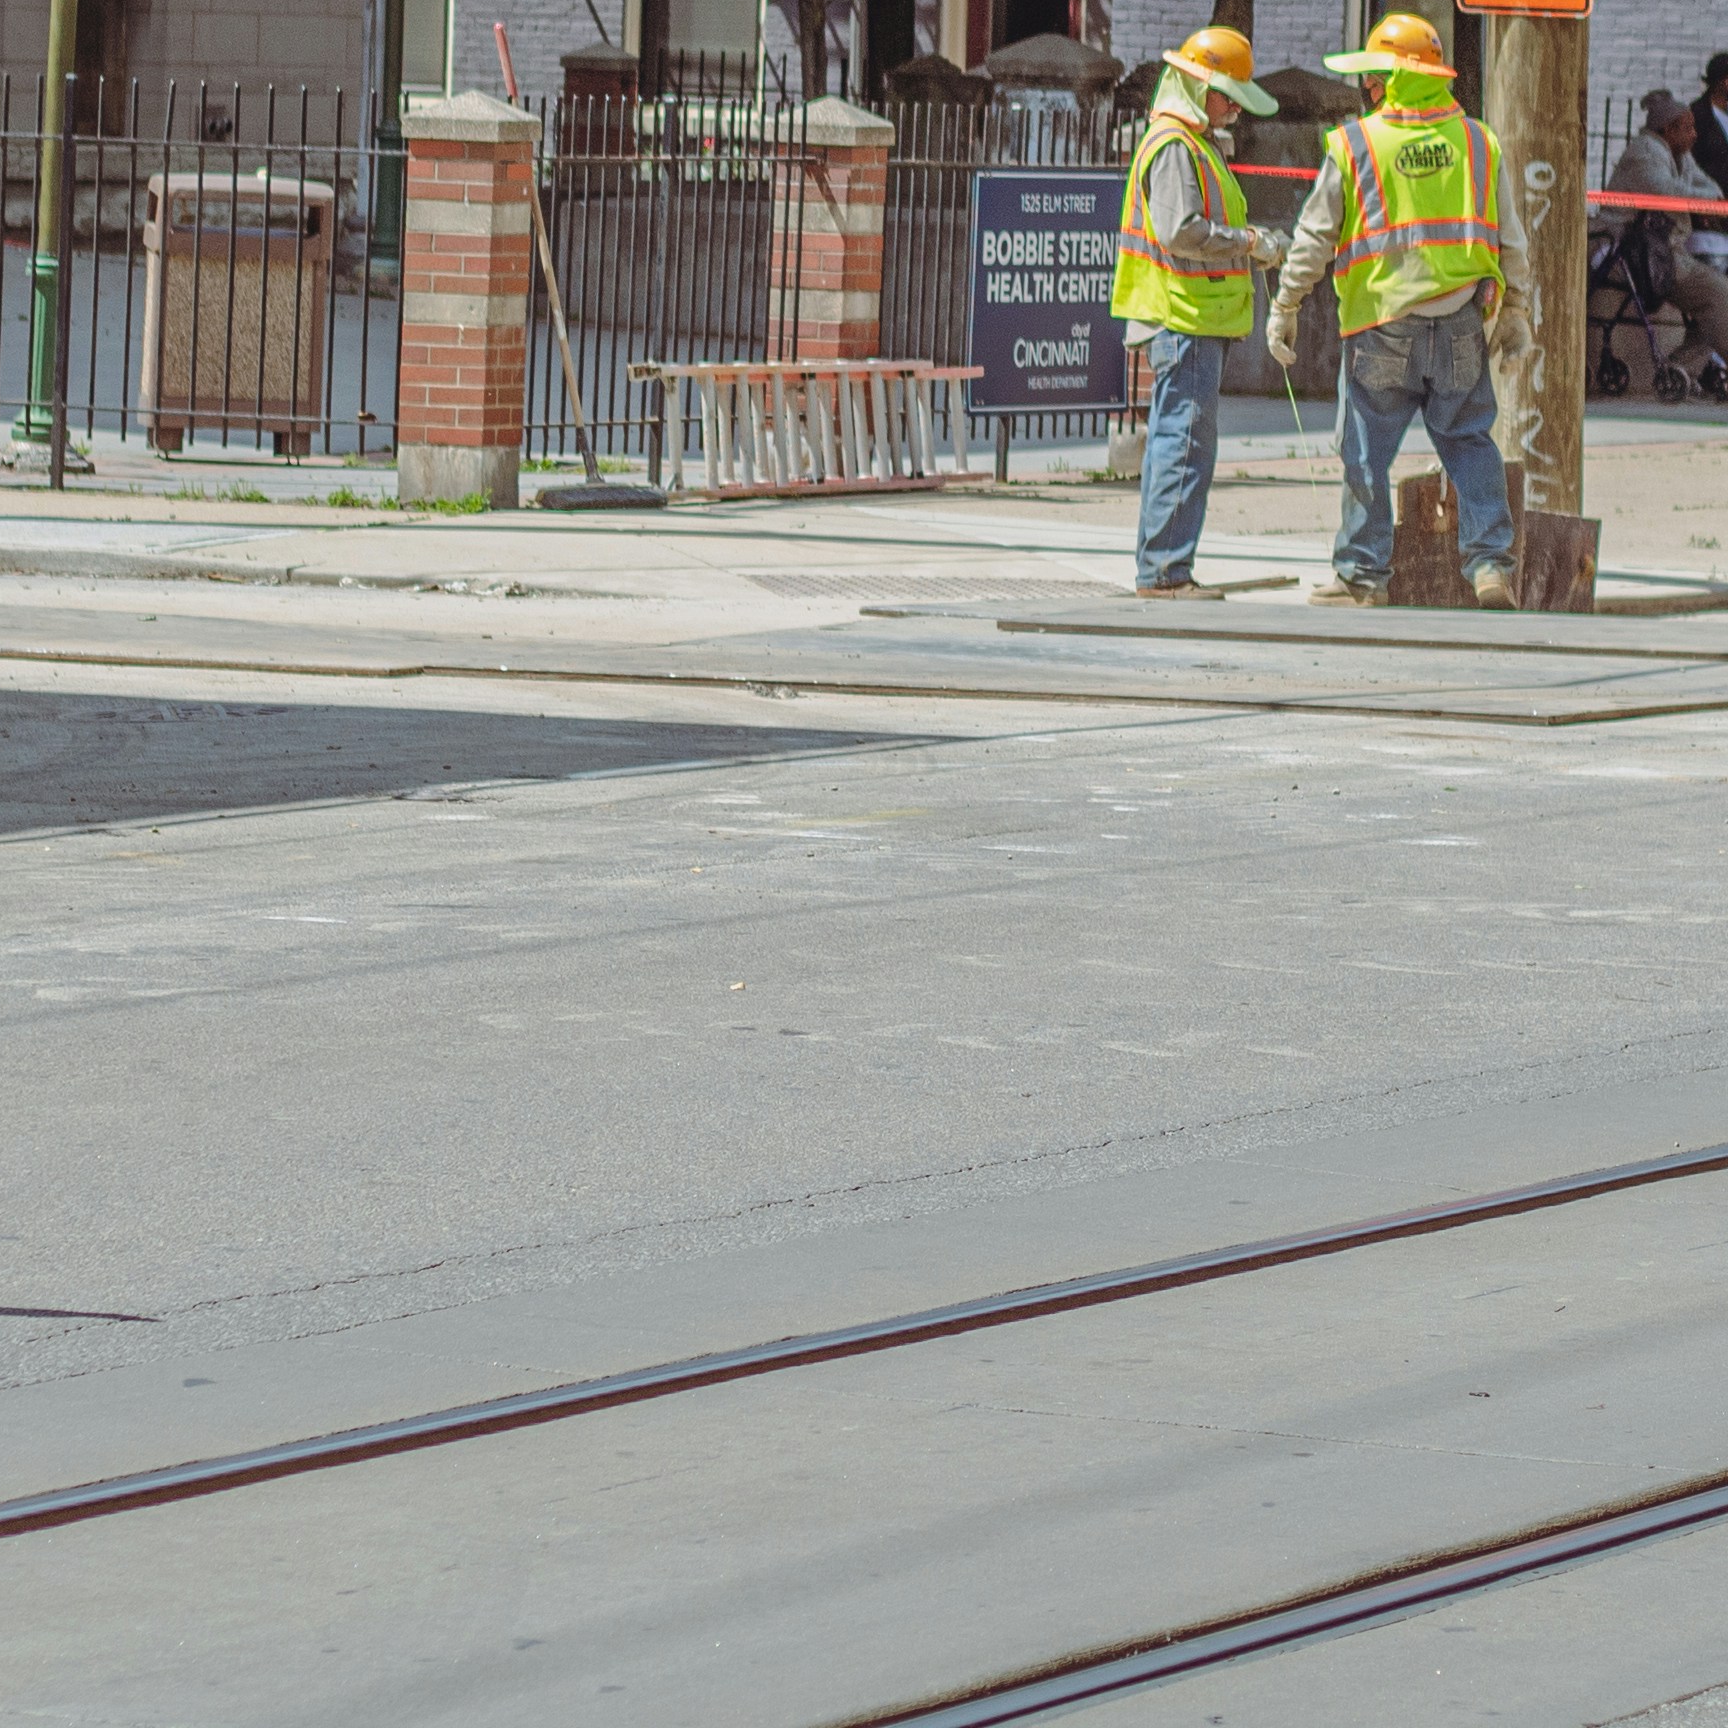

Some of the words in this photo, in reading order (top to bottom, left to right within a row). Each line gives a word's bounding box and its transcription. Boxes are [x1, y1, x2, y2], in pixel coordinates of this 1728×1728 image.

[1401, 143, 1447, 157] TEAM
[1020, 192, 1041, 213] 1525
[1043, 192, 1062, 213] ELM
[1063, 192, 1097, 213] STREET
[982, 230, 1054, 266] BOBBIE
[987, 271, 1054, 304] HEALTH
[1013, 337, 1090, 369] CINCINNATI
[1027, 375, 1051, 390] HEALTH
[1052, 375, 1089, 390] DEPARTMENT
